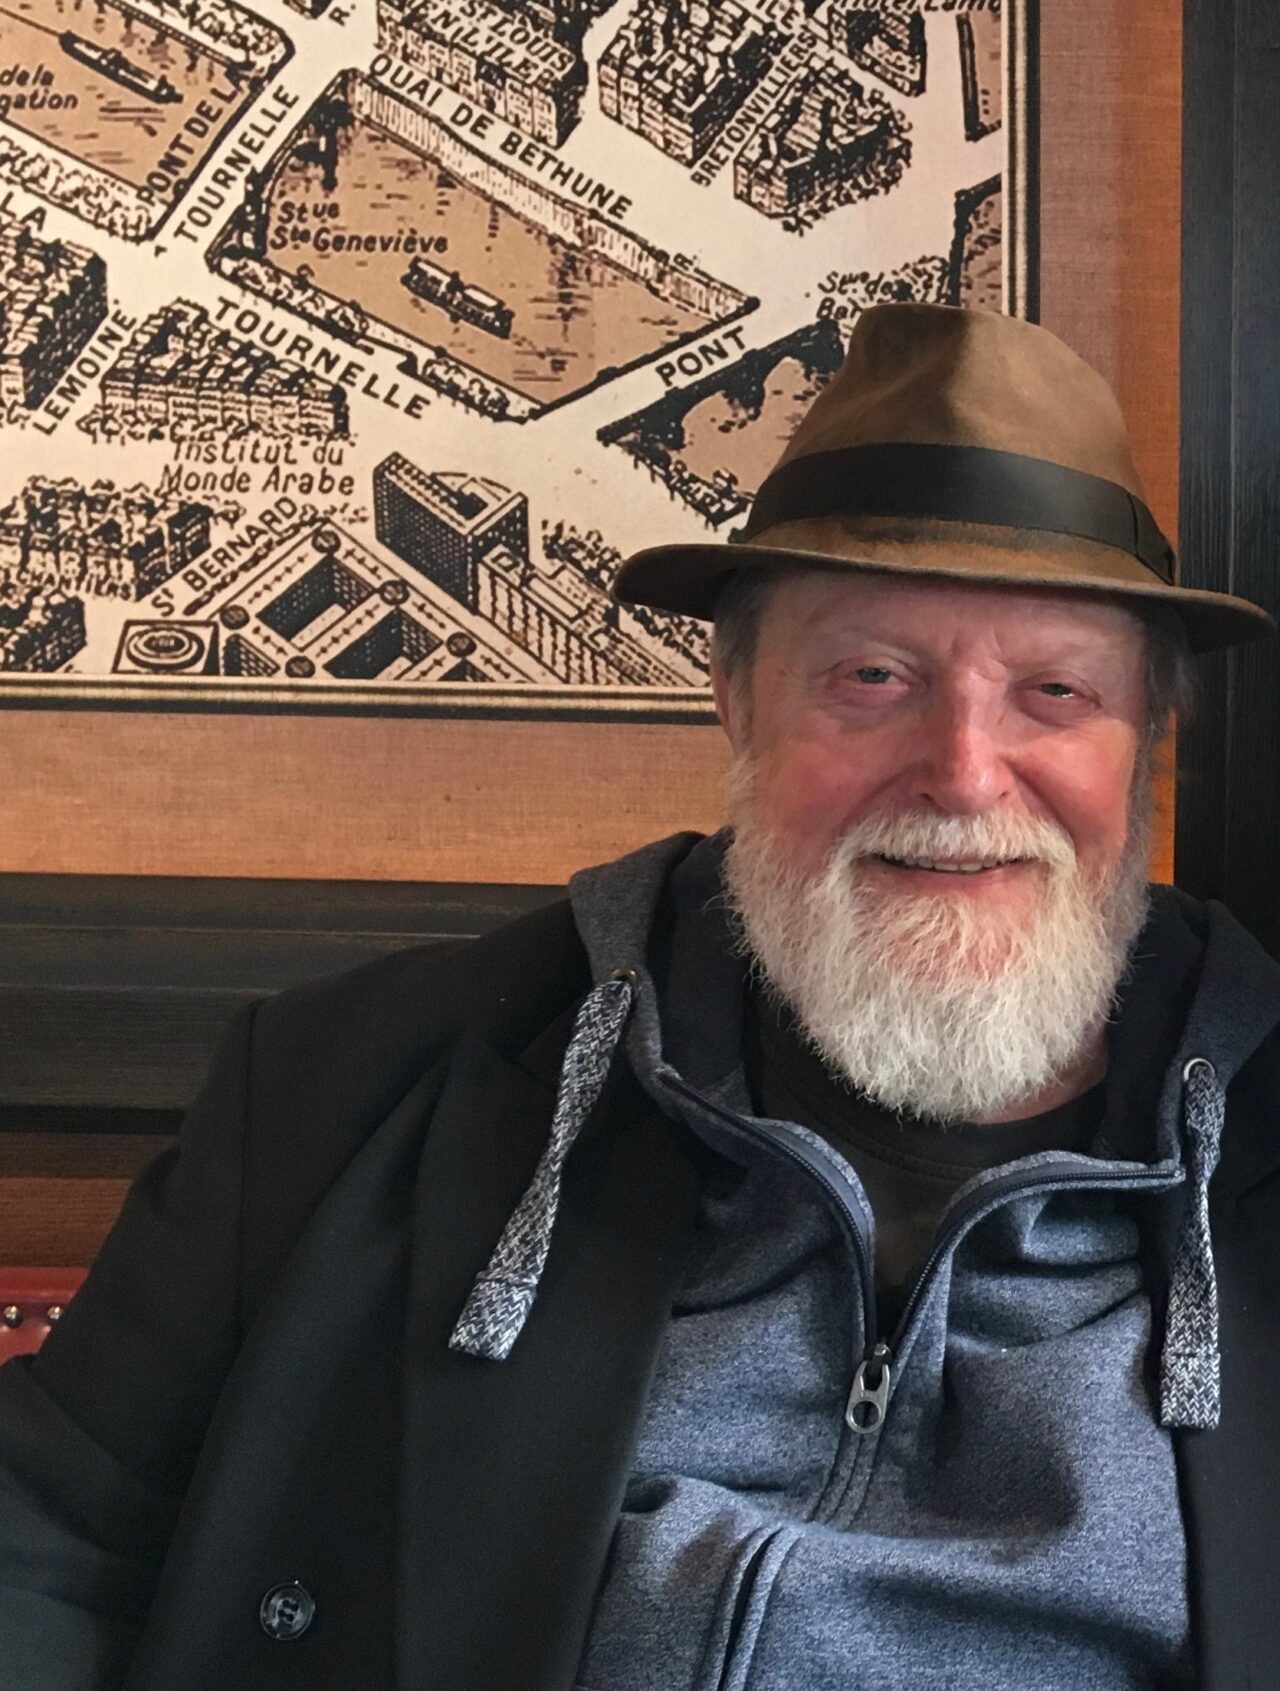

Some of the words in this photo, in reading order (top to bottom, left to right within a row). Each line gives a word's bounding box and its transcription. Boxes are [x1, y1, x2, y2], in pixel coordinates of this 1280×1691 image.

[490, 16, 574, 72] LOUIS
[369, 53, 443, 107] QUAI
[451, 102, 496, 140] DE
[500, 130, 633, 220] BETHUNE
[690, 31, 818, 188] BRETONVILLIERS
[135, 133, 195, 207] PONT
[174, 85, 300, 243] TOURNELLE
[33, 309, 138, 436] LEMOINE
[215, 296, 431, 420] TOURNELLE
[655, 325, 746, 387] PONT
[157, 464, 251, 496] Monde
[262, 464, 355, 496] Arabe
[174, 438, 298, 464] Institut
[312, 437, 344, 466] du
[182, 496, 298, 592] BERNARD
